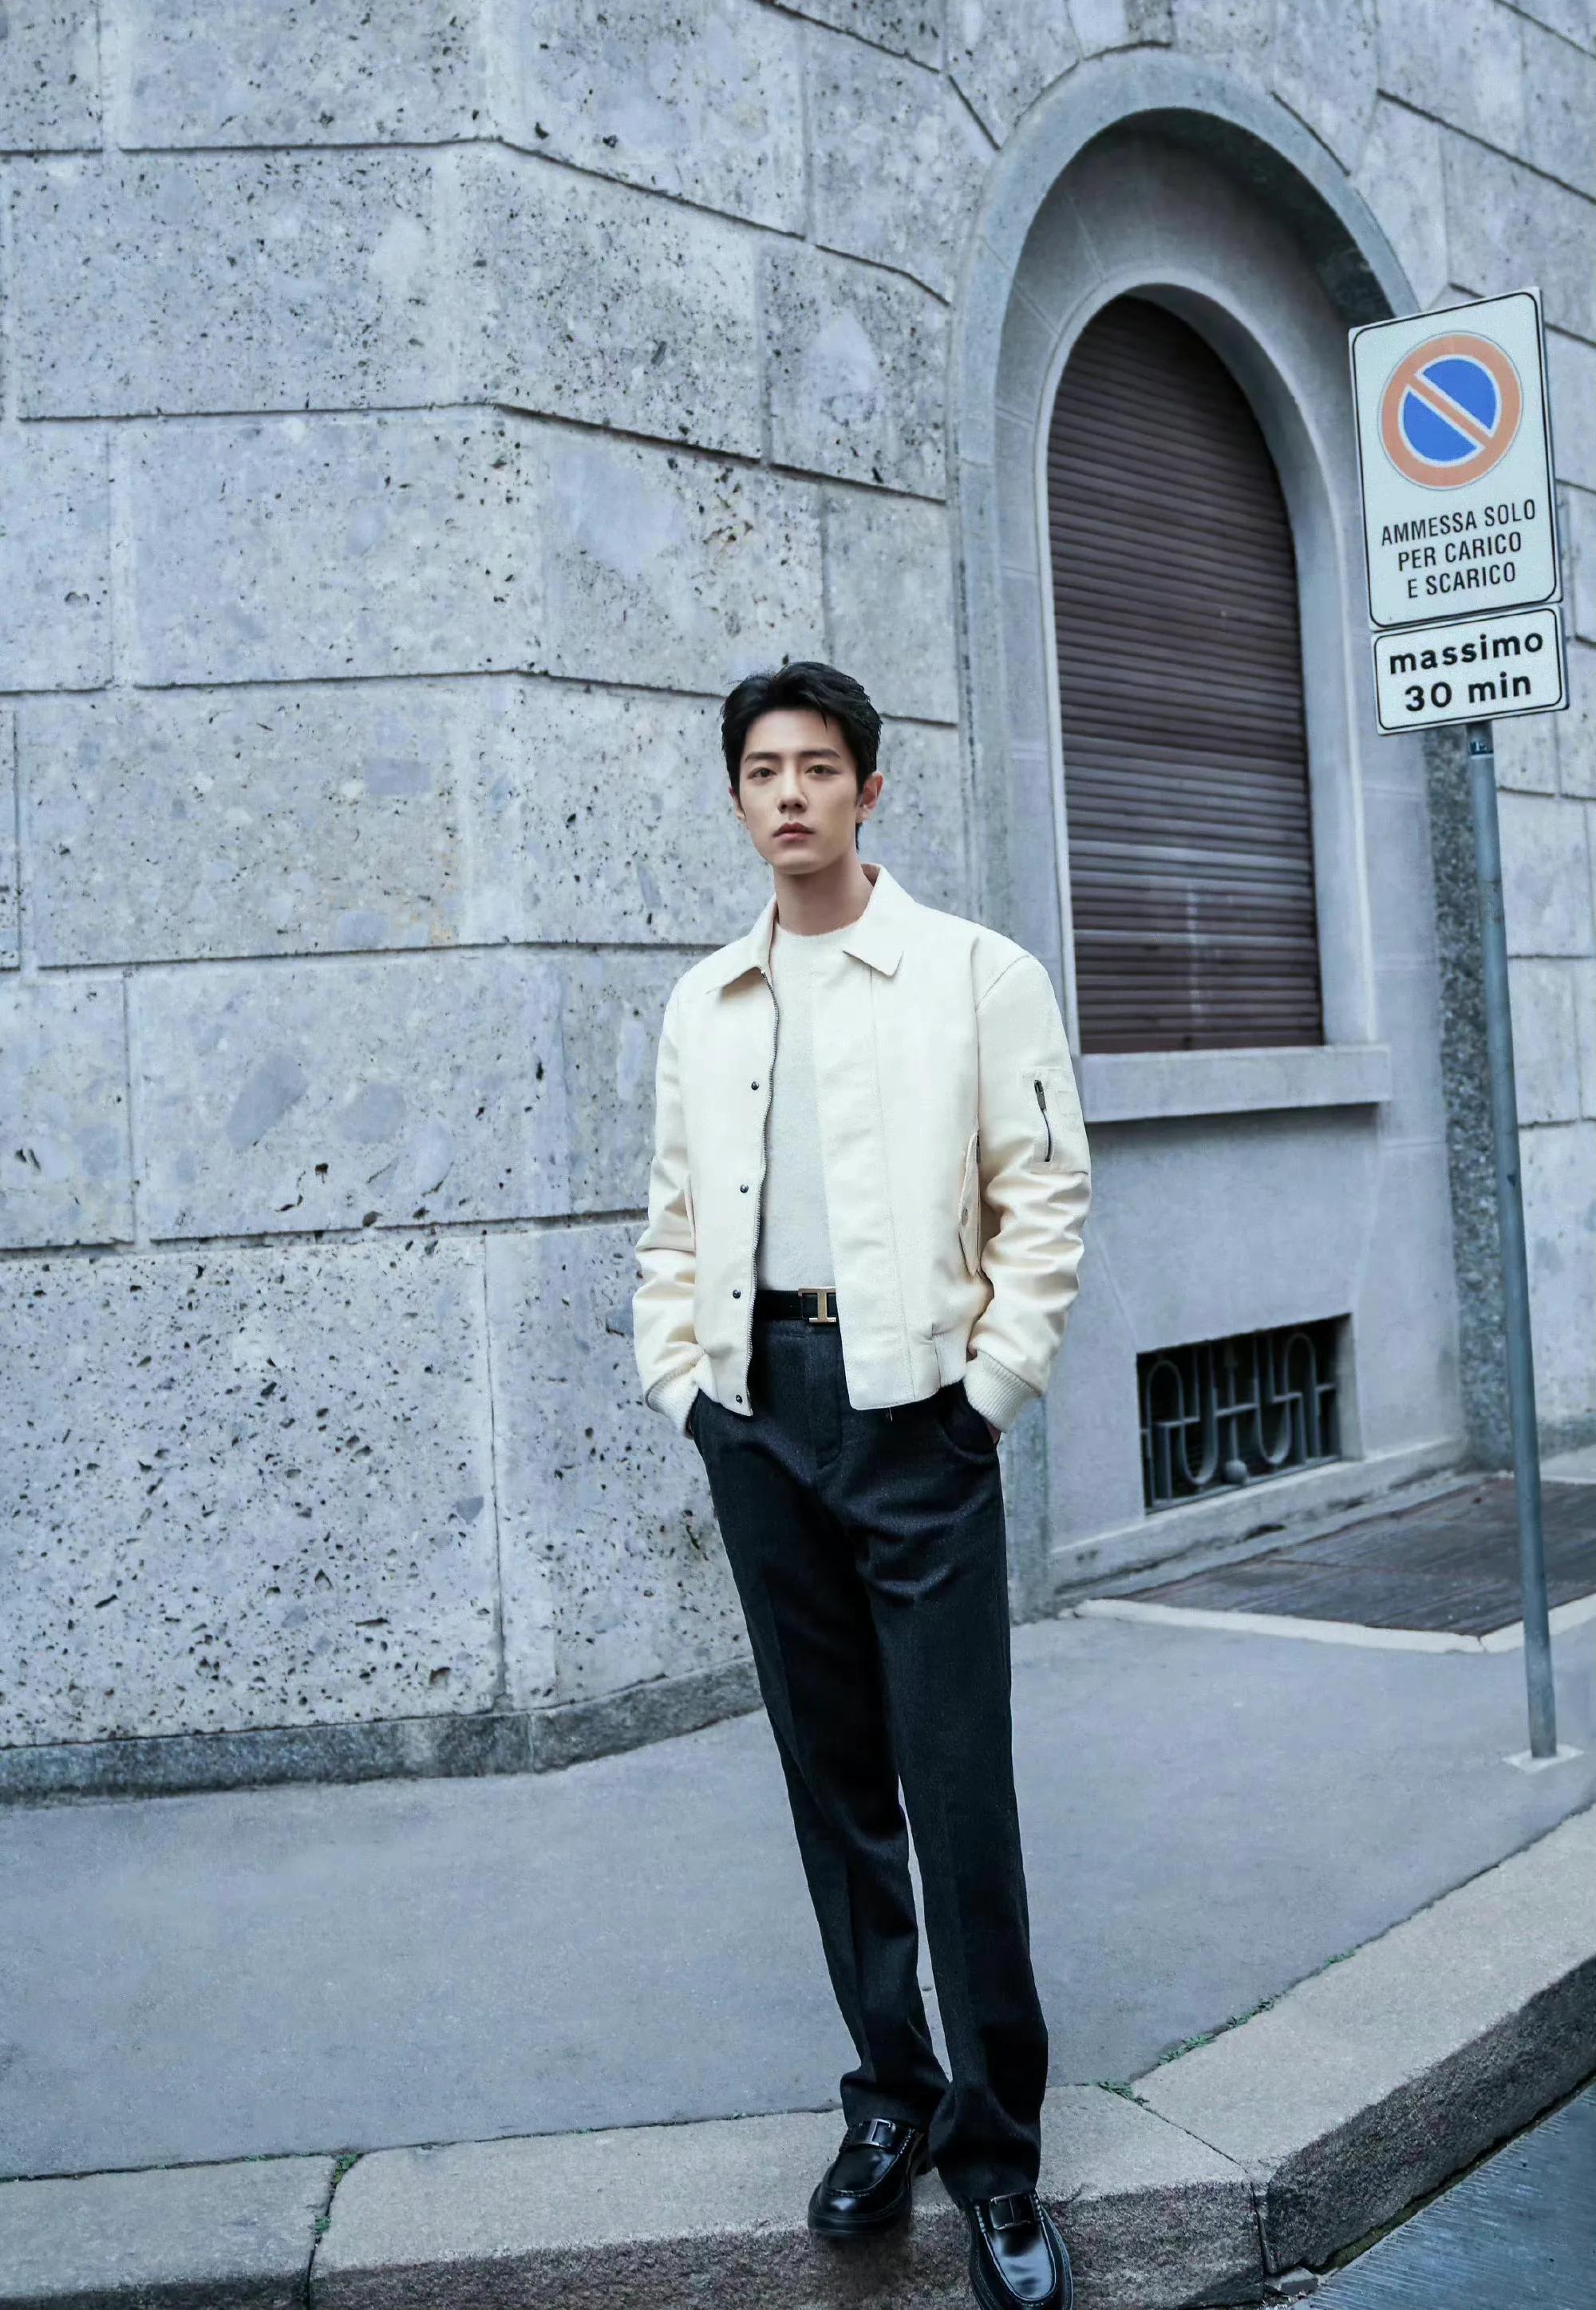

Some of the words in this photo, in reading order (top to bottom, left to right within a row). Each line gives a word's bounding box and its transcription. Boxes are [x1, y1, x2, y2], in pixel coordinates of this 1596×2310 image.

[1381, 510, 1477, 546] AMMESSA
[1484, 499, 1535, 527] SOLO
[1398, 547, 1436, 572] PER
[1445, 532, 1521, 563] CARICO
[1408, 579, 1418, 599] E
[1426, 561, 1515, 595] SCARICO
[1389, 632, 1543, 674] massimo
[1404, 682, 1452, 712] 30
[1468, 671, 1531, 703] min
